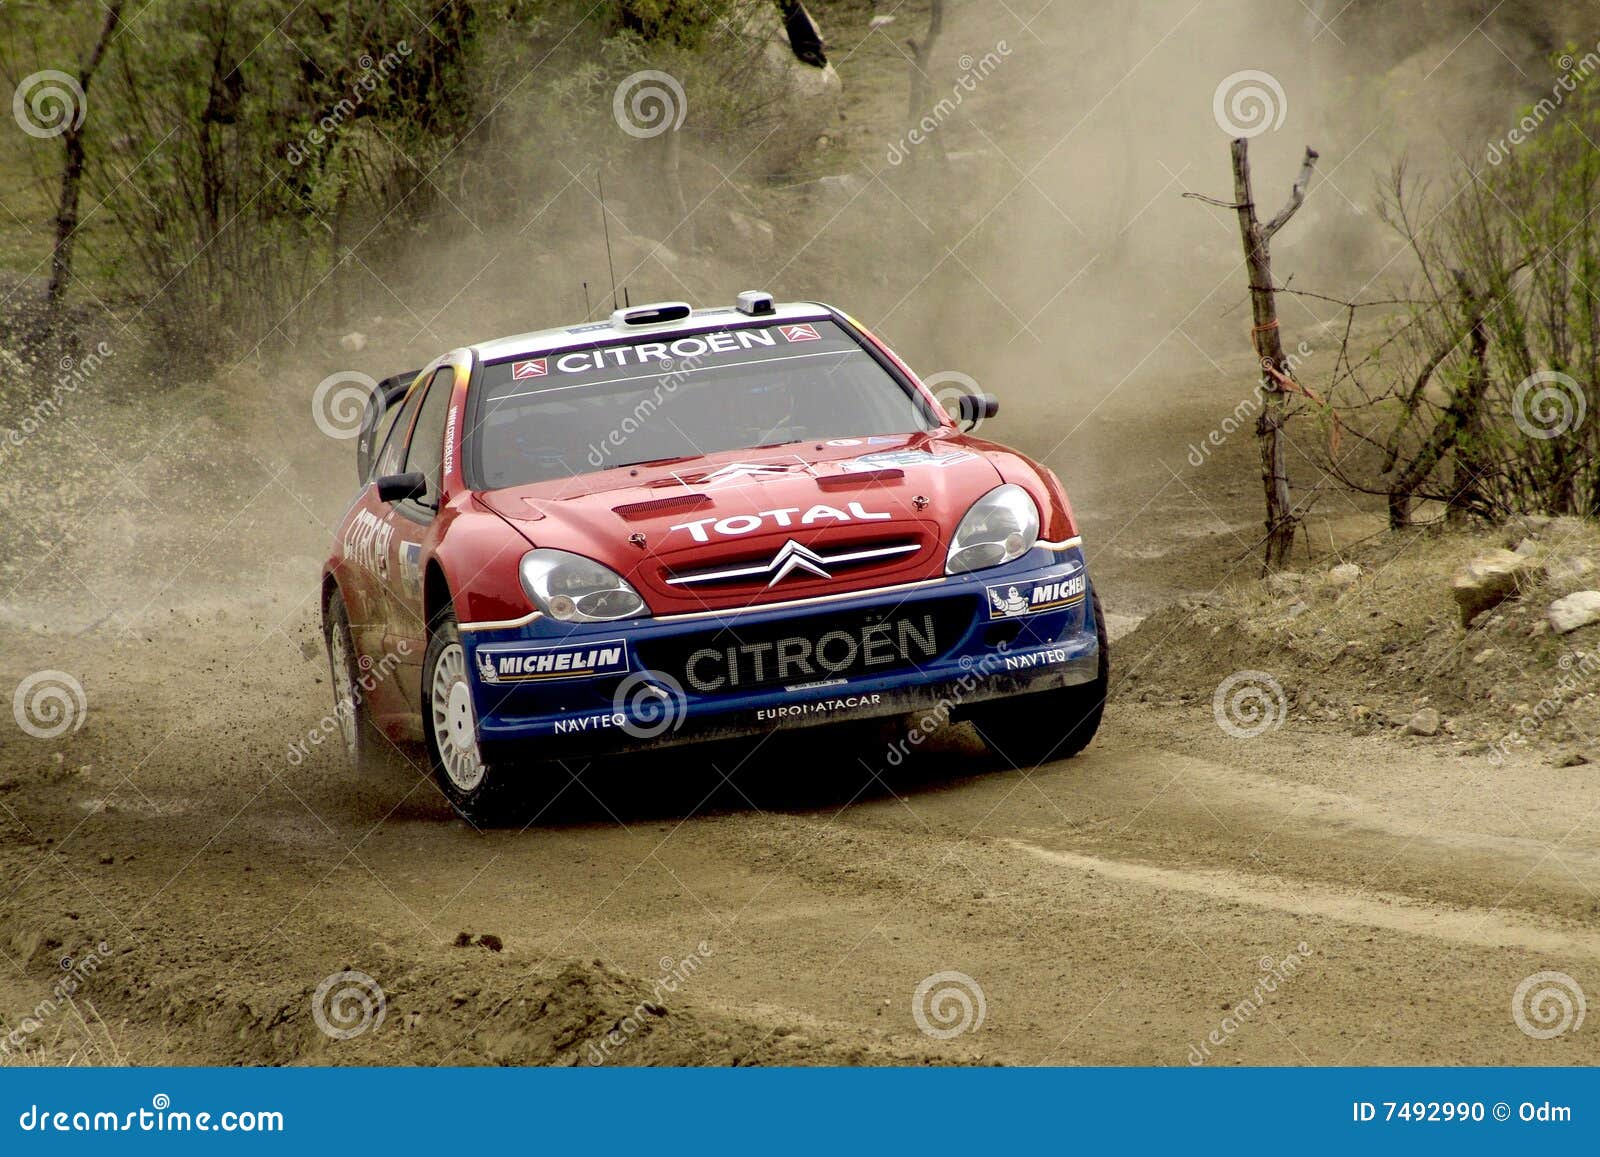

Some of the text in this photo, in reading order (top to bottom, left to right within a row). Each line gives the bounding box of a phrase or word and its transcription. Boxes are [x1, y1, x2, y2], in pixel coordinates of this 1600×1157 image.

[556, 329, 776, 373] CITROËN
[671, 502, 892, 542] TOTAL
[499, 648, 621, 674] MICHELIN
[685, 614, 938, 692] CITROËN
[1005, 649, 1066, 670] NAVTEQ
[554, 713, 626, 735] NAVTEQ
